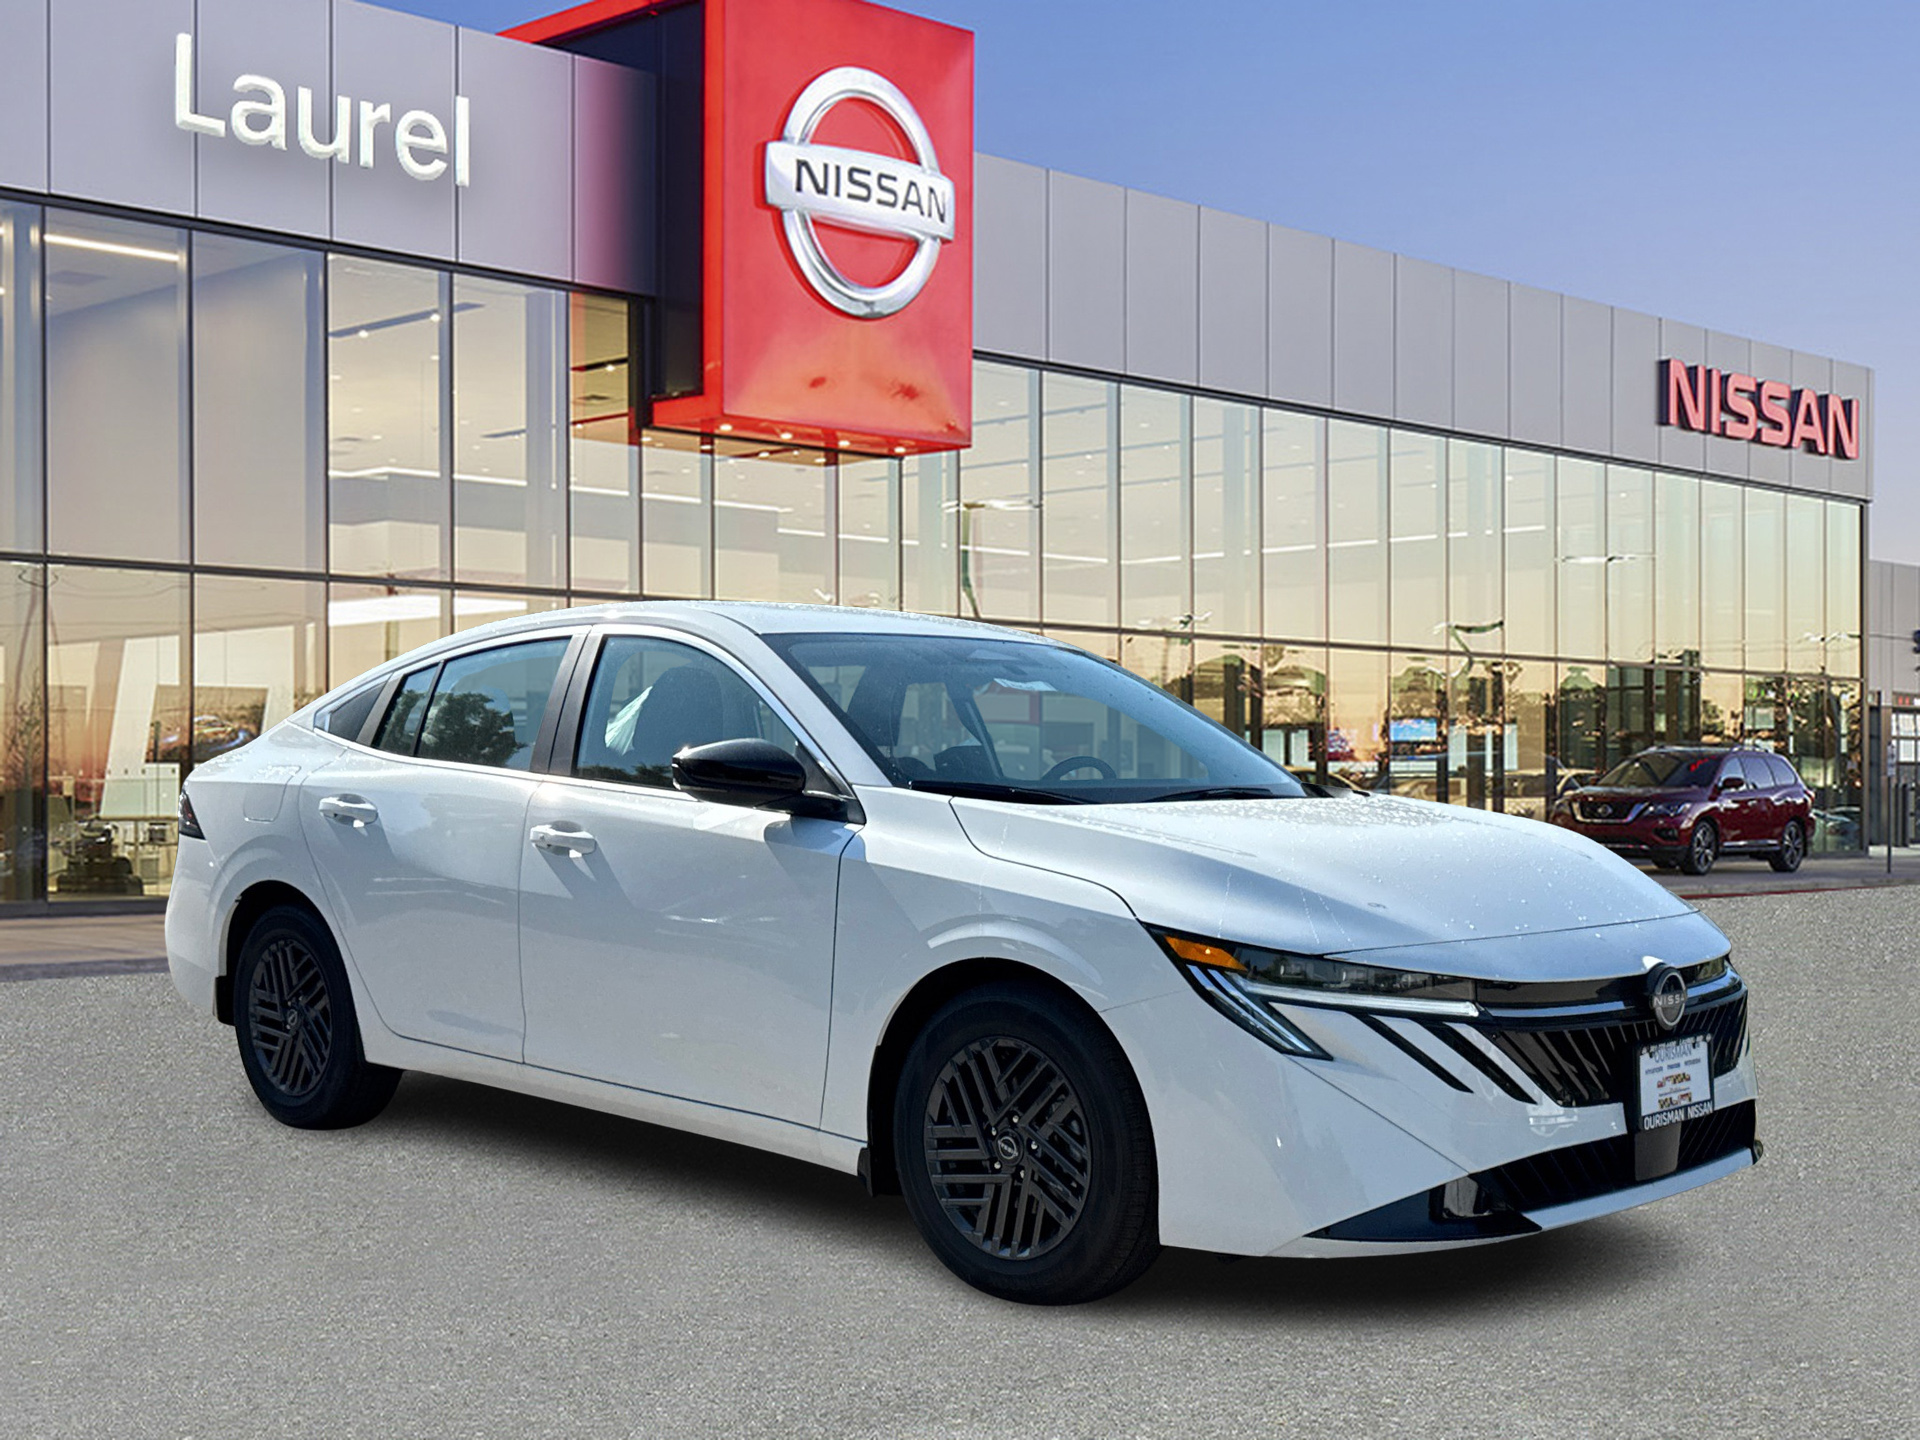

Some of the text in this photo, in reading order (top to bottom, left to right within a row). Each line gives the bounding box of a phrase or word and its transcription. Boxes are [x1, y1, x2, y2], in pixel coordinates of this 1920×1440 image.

[175, 33, 470, 187] Laurel
[795, 158, 946, 223] NISSAN
[1659, 358, 1859, 459] NISSAN
[1653, 993, 1685, 1007] NISS
[1644, 1099, 1714, 1130] OURISMAN NISSAN
